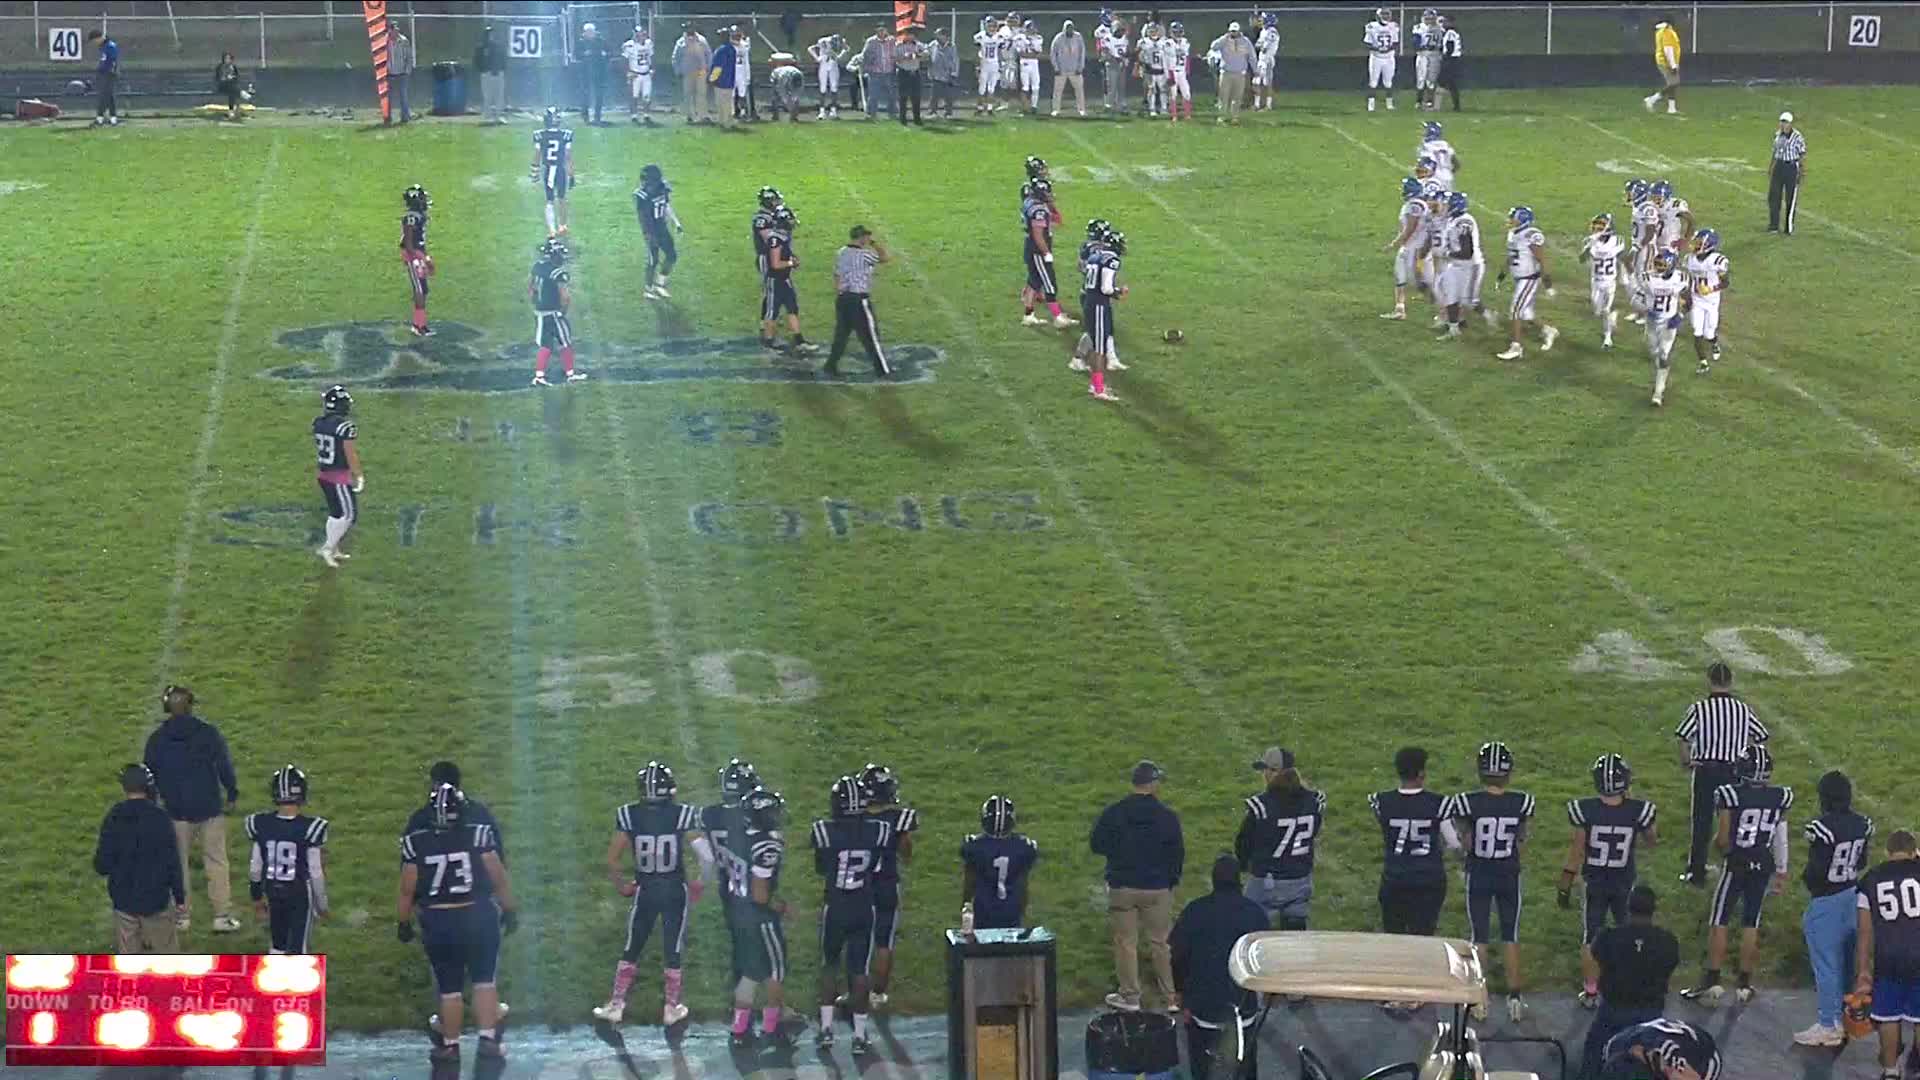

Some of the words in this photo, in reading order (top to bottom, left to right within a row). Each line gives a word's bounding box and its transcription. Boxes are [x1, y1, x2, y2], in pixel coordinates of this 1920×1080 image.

[53, 31, 80, 57] 40
[513, 29, 541, 54] 50
[1853, 18, 1878, 44] 20
[547, 140, 559, 161] 2
[1594, 258, 1614, 276] 22
[1653, 295, 1671, 313] 21
[535, 650, 820, 712] 50
[1271, 815, 1314, 858] 72
[1389, 818, 1431, 856] 75
[1474, 816, 1519, 859] 85
[1587, 825, 1633, 869] 53
[1736, 808, 1780, 848] 84
[265, 840, 296, 881] 18
[423, 851, 472, 896] 73
[634, 834, 676, 874] 80
[836, 849, 872, 890] 12
[992, 856, 1010, 899] 1
[1876, 878, 1920, 920] 50
